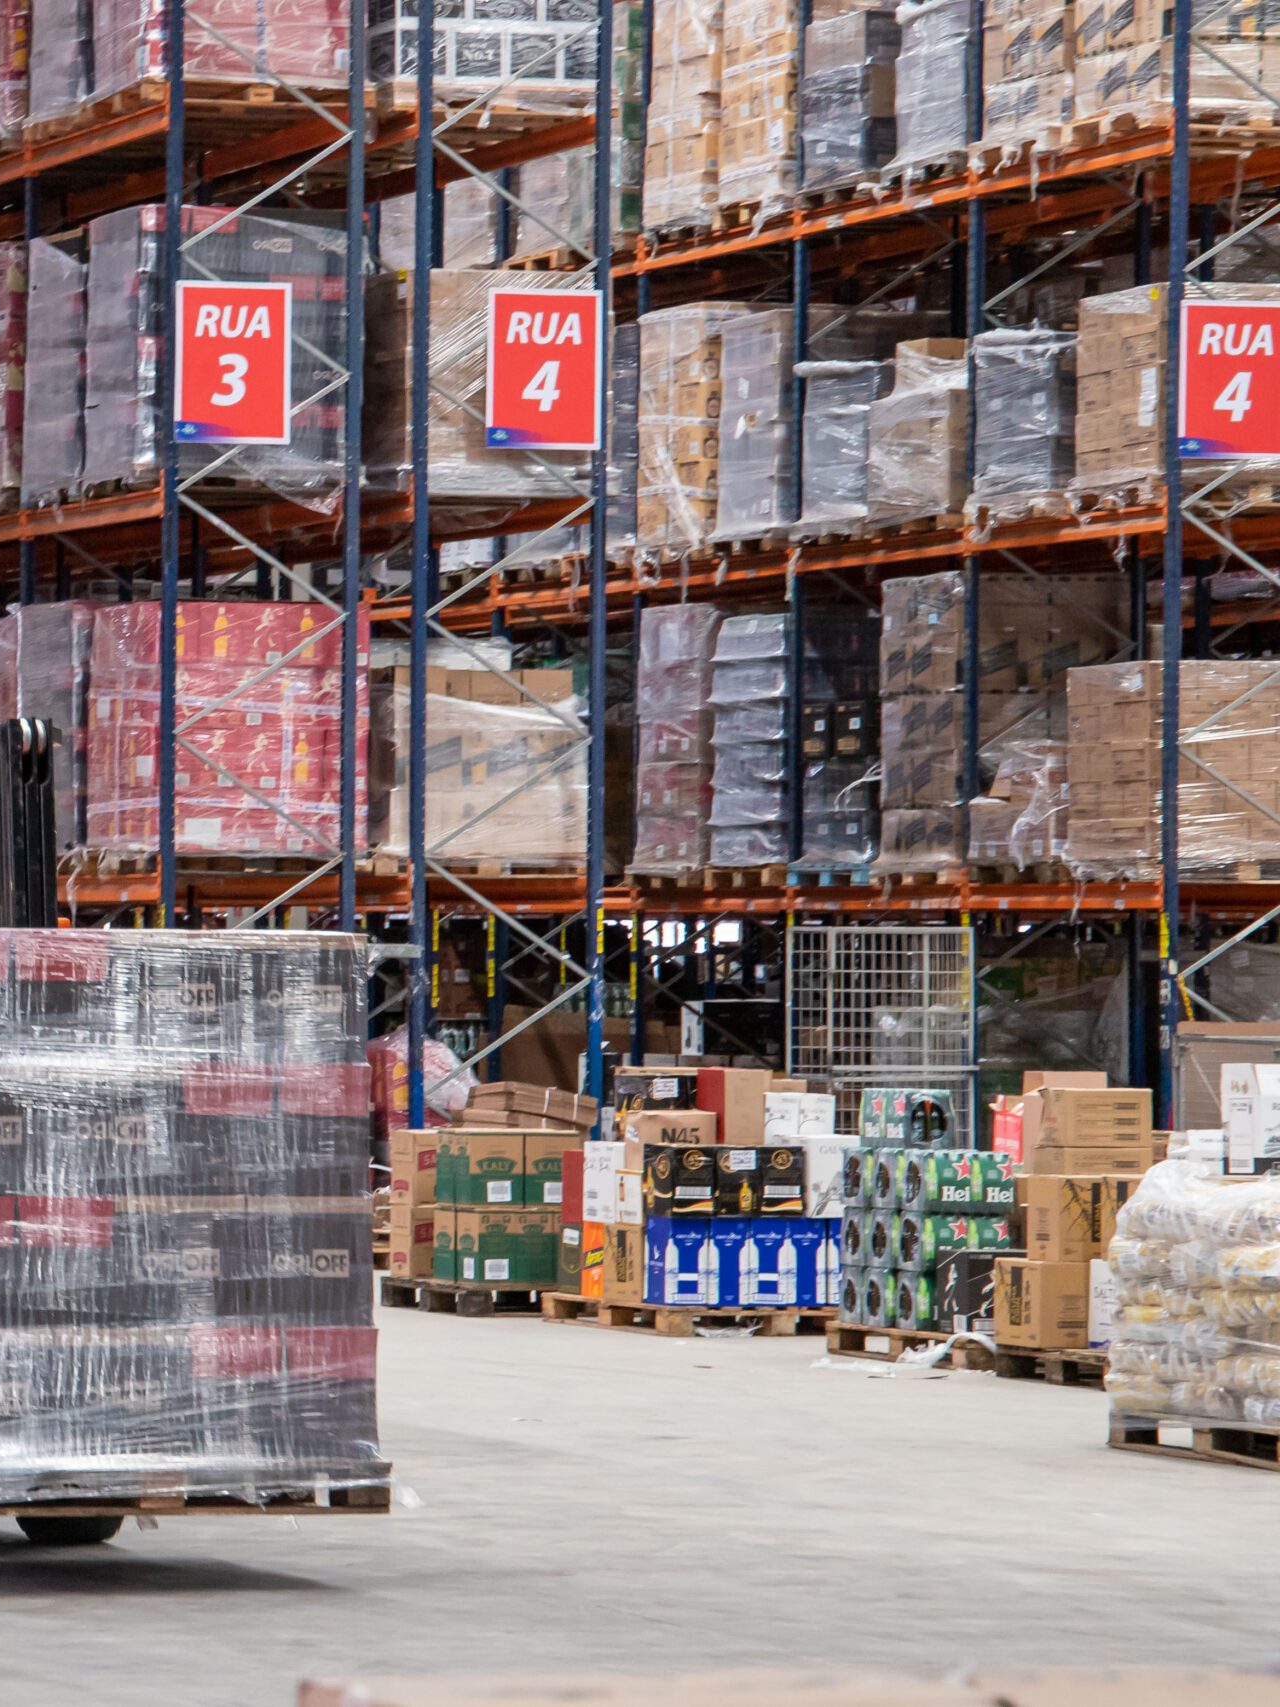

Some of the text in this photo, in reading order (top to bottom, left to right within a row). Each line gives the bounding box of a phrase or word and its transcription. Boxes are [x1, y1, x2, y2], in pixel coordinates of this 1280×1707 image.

[195, 305, 271, 338] RUA
[506, 312, 581, 344] RUA
[1199, 324, 1273, 355] RUA
[211, 354, 248, 406] 3
[522, 361, 560, 411] 4
[1214, 372, 1252, 421] 4
[482, 1162, 510, 1172] KALY
[942, 1186, 970, 1202] Hei
[986, 1187, 1014, 1202] Hei
